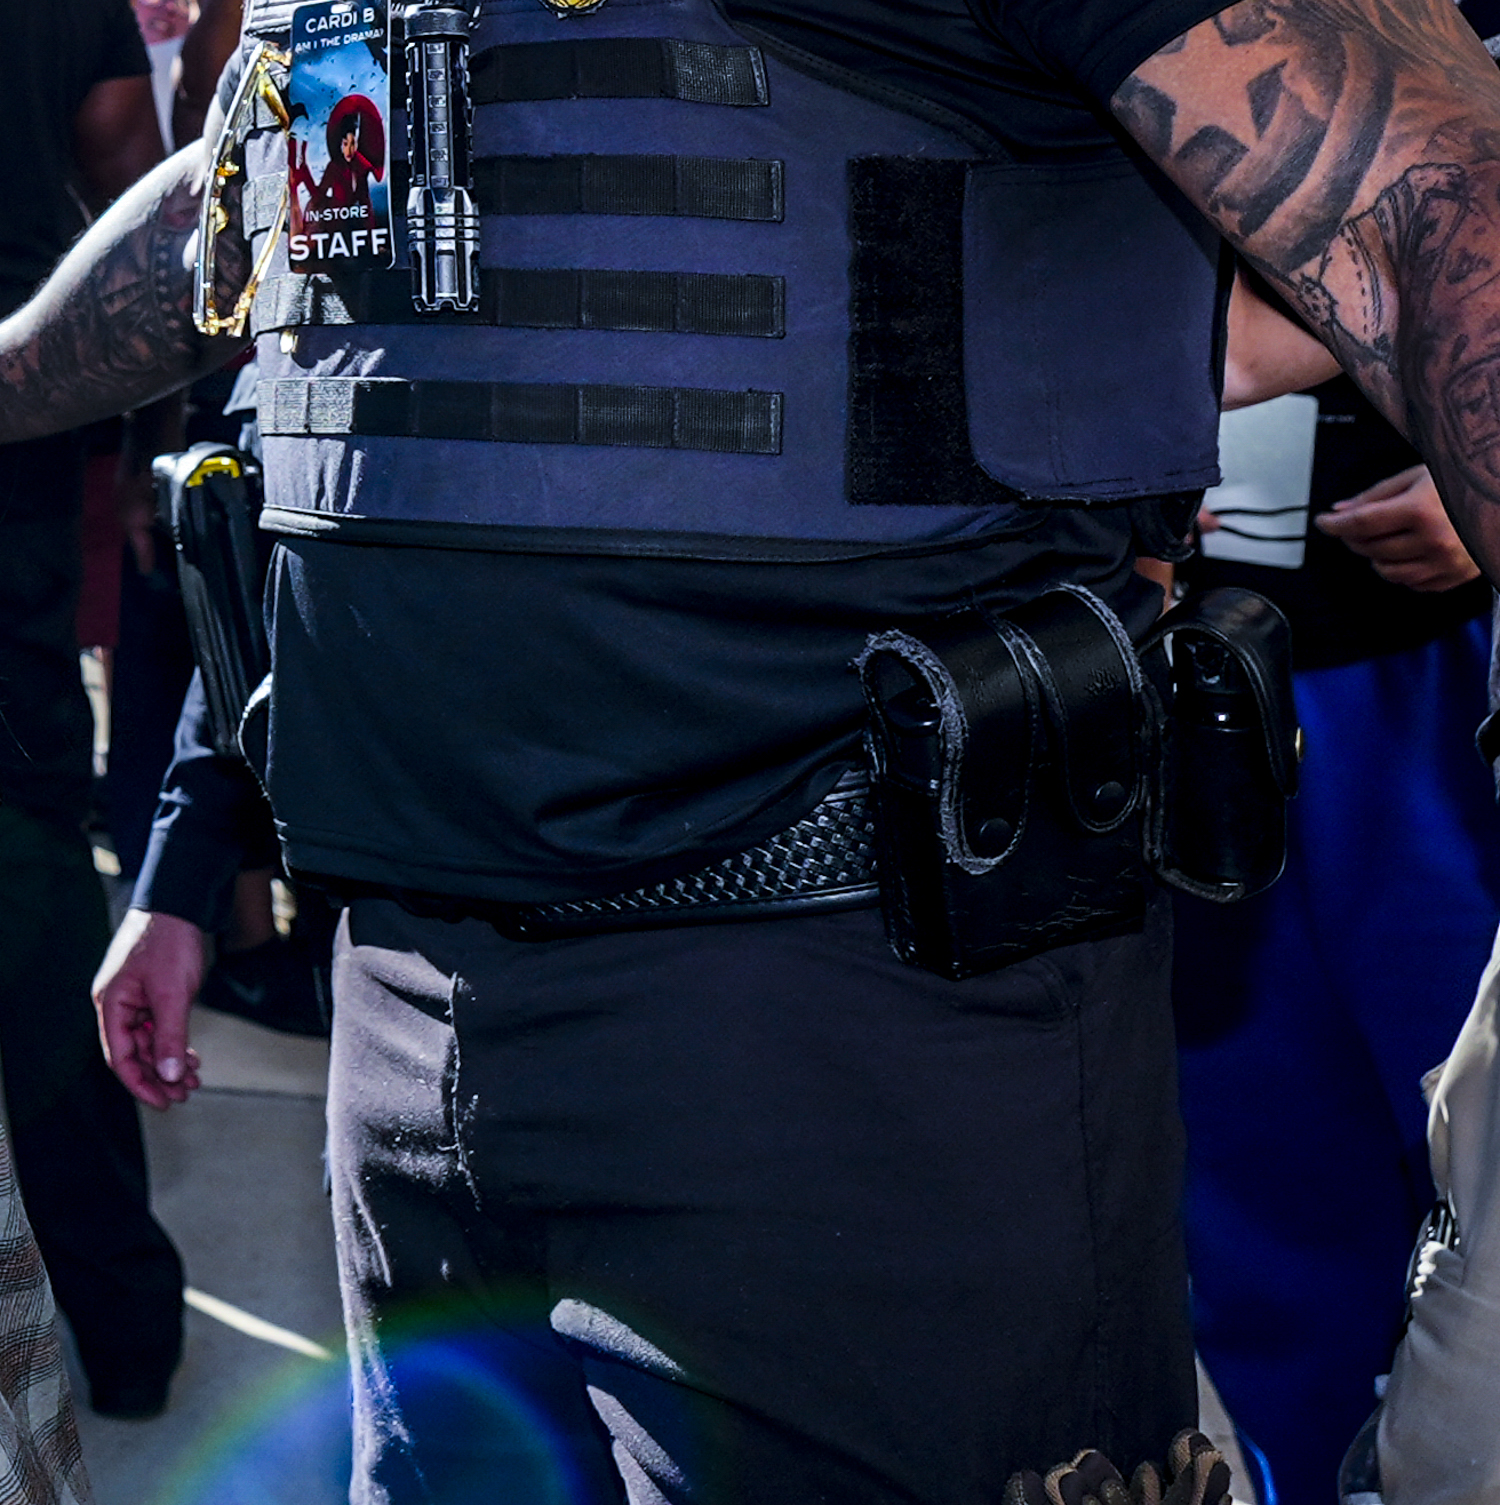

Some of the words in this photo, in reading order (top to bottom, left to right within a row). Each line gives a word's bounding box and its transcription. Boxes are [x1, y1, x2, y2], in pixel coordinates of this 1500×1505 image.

[305, 10, 358, 34] CARDI
[363, 7, 375, 23] B
[294, 40, 312, 54] AM
[313, 39, 318, 50] I
[320, 35, 341, 48] THE
[305, 204, 369, 223] IN-STORE
[289, 228, 389, 262] STAFF
